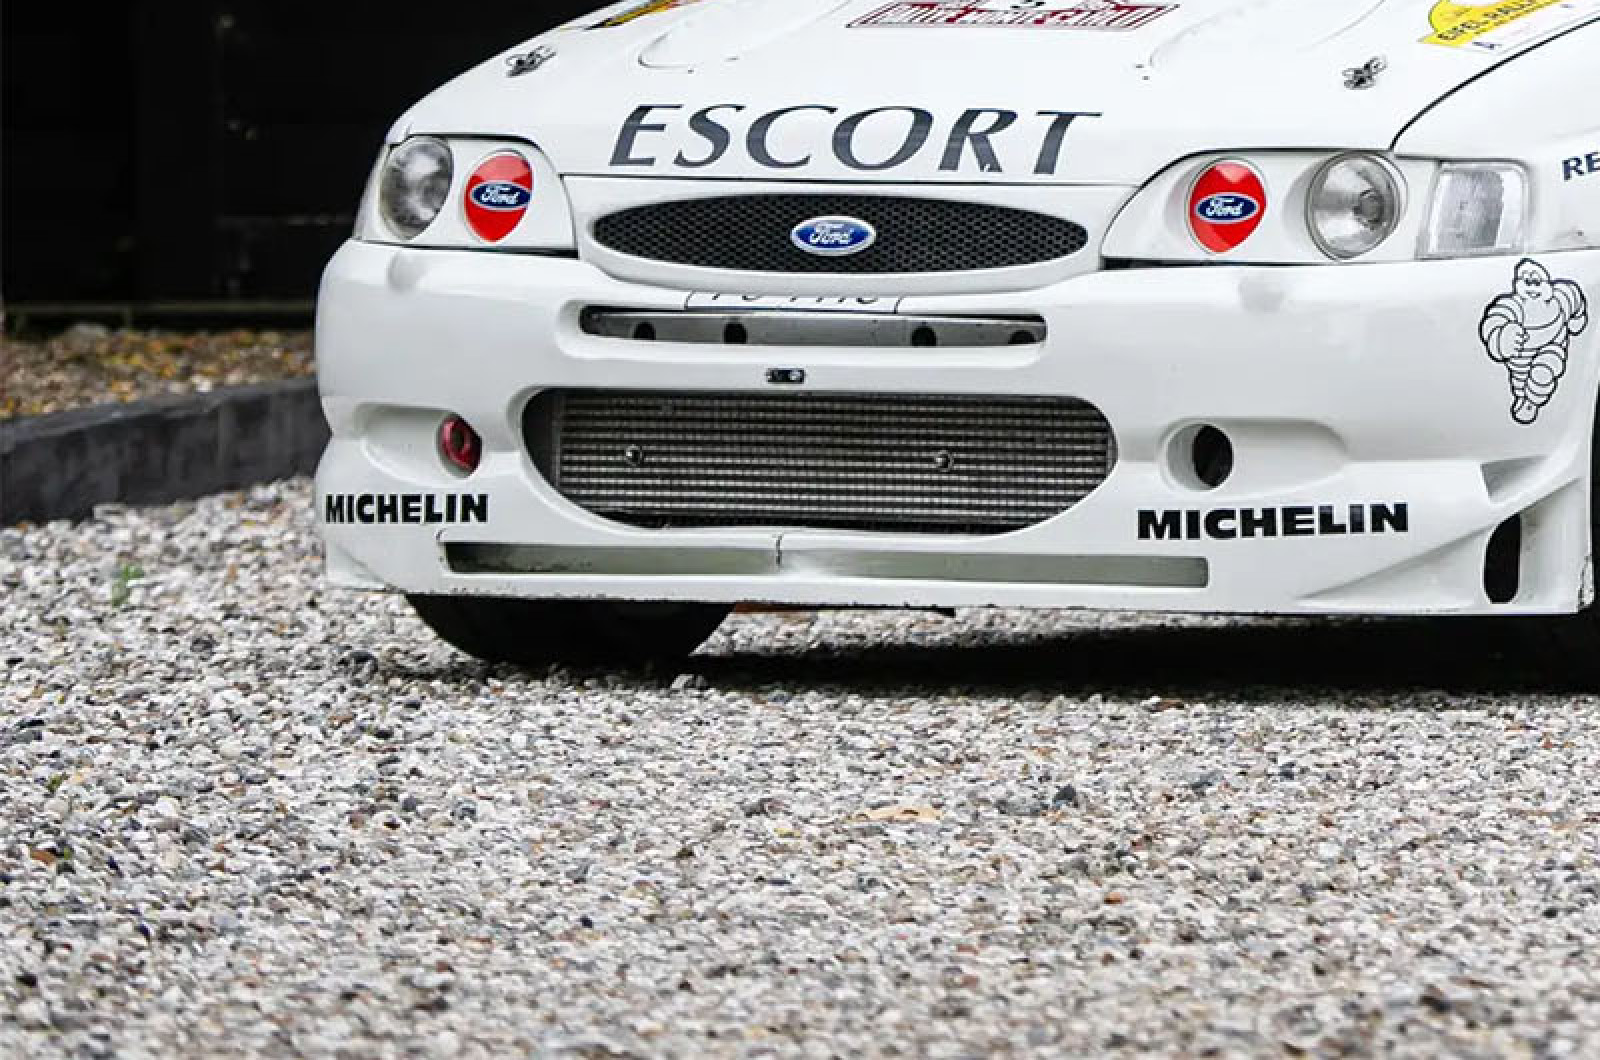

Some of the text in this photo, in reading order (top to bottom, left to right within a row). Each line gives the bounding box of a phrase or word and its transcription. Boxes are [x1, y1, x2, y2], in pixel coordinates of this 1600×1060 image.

[609, 103, 1102, 176] ESCORT
[325, 493, 489, 524] MICHELIN
[1138, 501, 1409, 541] MICHELIN
